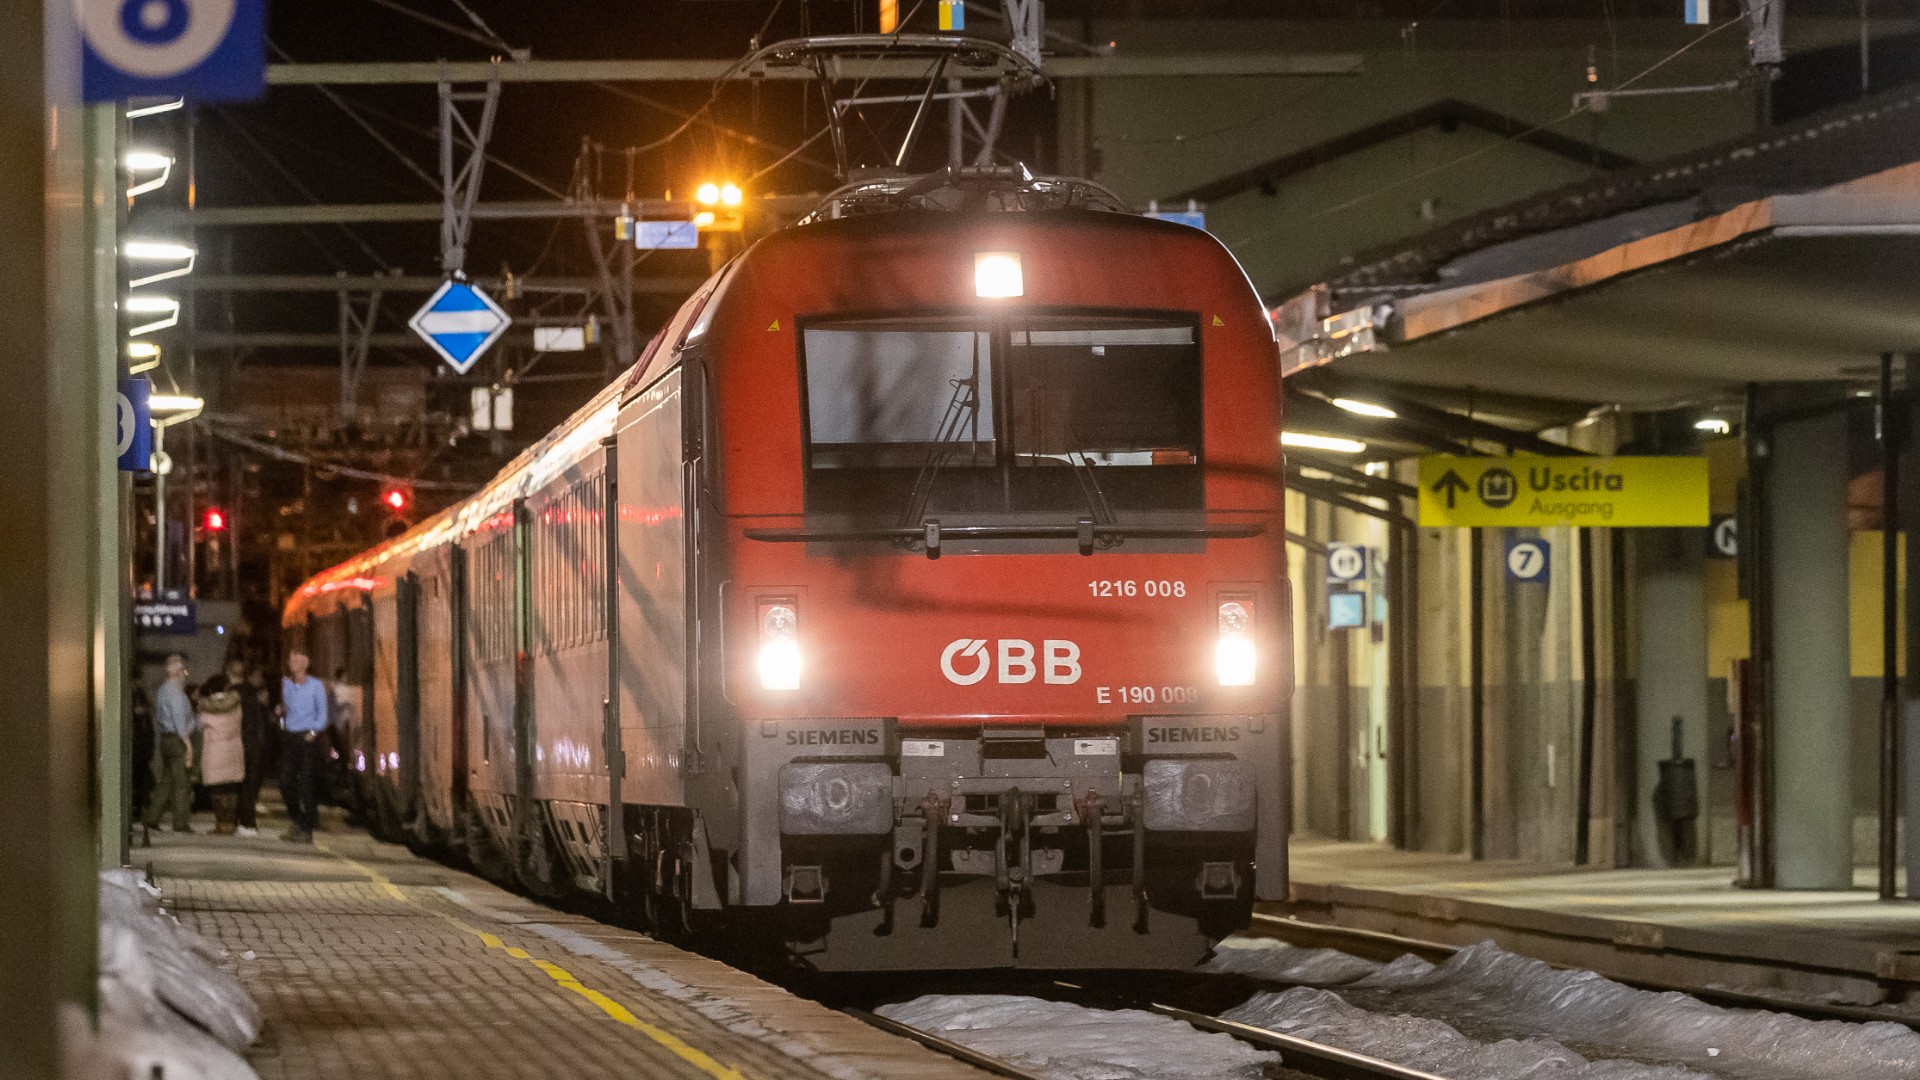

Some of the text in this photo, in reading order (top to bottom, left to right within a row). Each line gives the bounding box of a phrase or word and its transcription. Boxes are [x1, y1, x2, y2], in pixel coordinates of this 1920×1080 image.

[1529, 467, 1623, 491] Uscita
[1530, 499, 1614, 520] Ausgang
[1518, 550, 1534, 571] 7
[1088, 580, 1186, 598] 1216 008
[1096, 686, 1112, 704] E
[1118, 686, 1156, 704] 190
[786, 729, 879, 746] SIEMENS
[1148, 727, 1240, 743] SIEMENS
